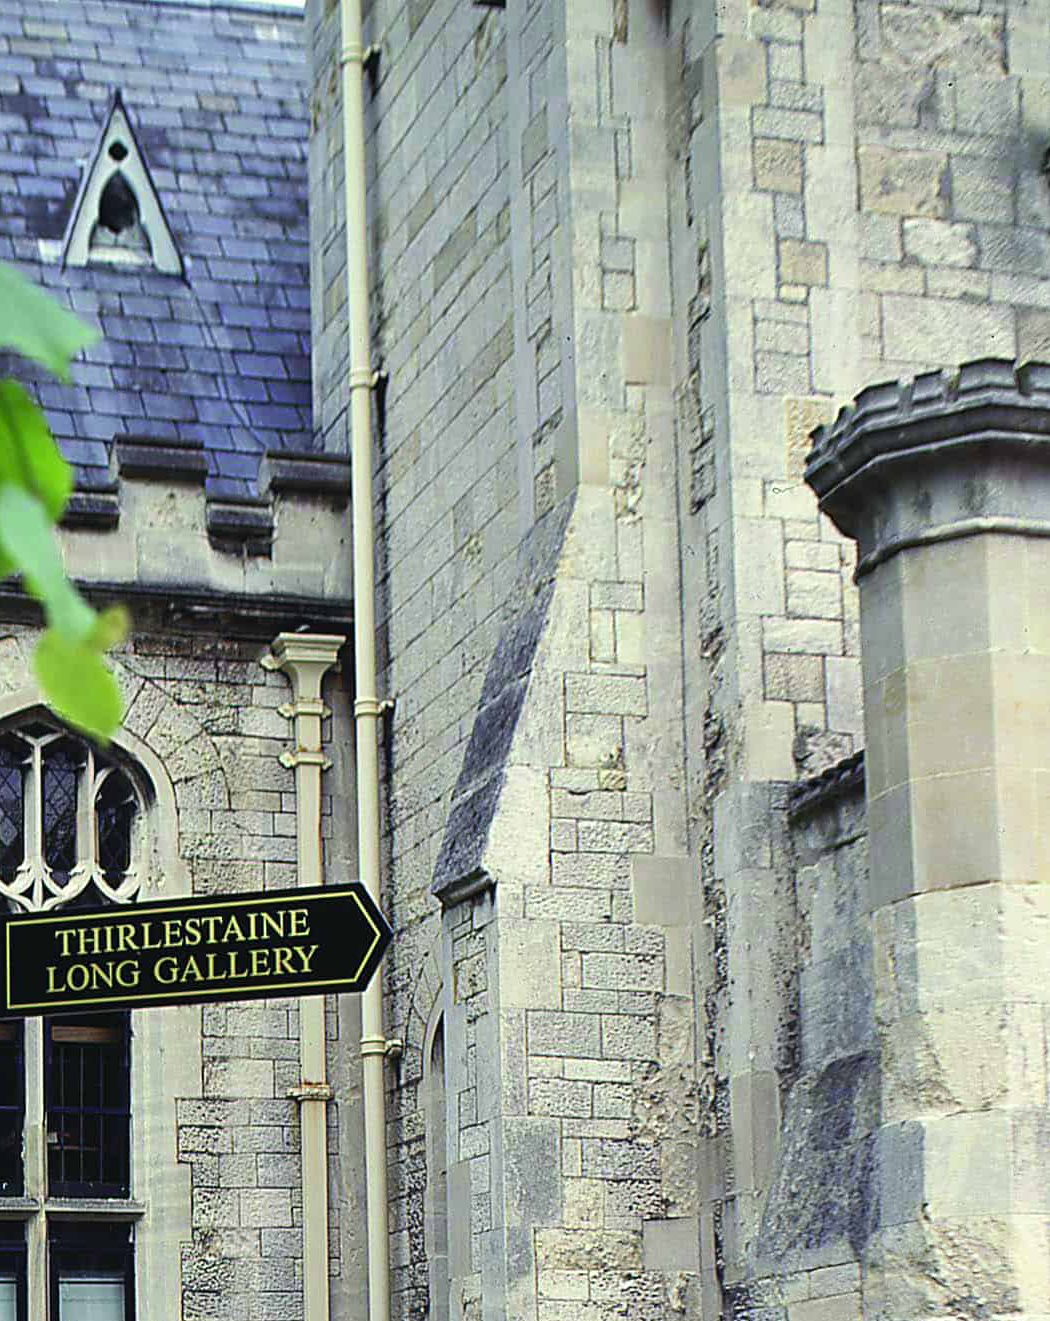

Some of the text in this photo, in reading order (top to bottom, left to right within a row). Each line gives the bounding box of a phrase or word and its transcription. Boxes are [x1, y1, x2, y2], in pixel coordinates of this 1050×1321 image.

[55, 908, 311, 957] THIRLESTAINE
[46, 944, 319, 994] LONG GALLERY
